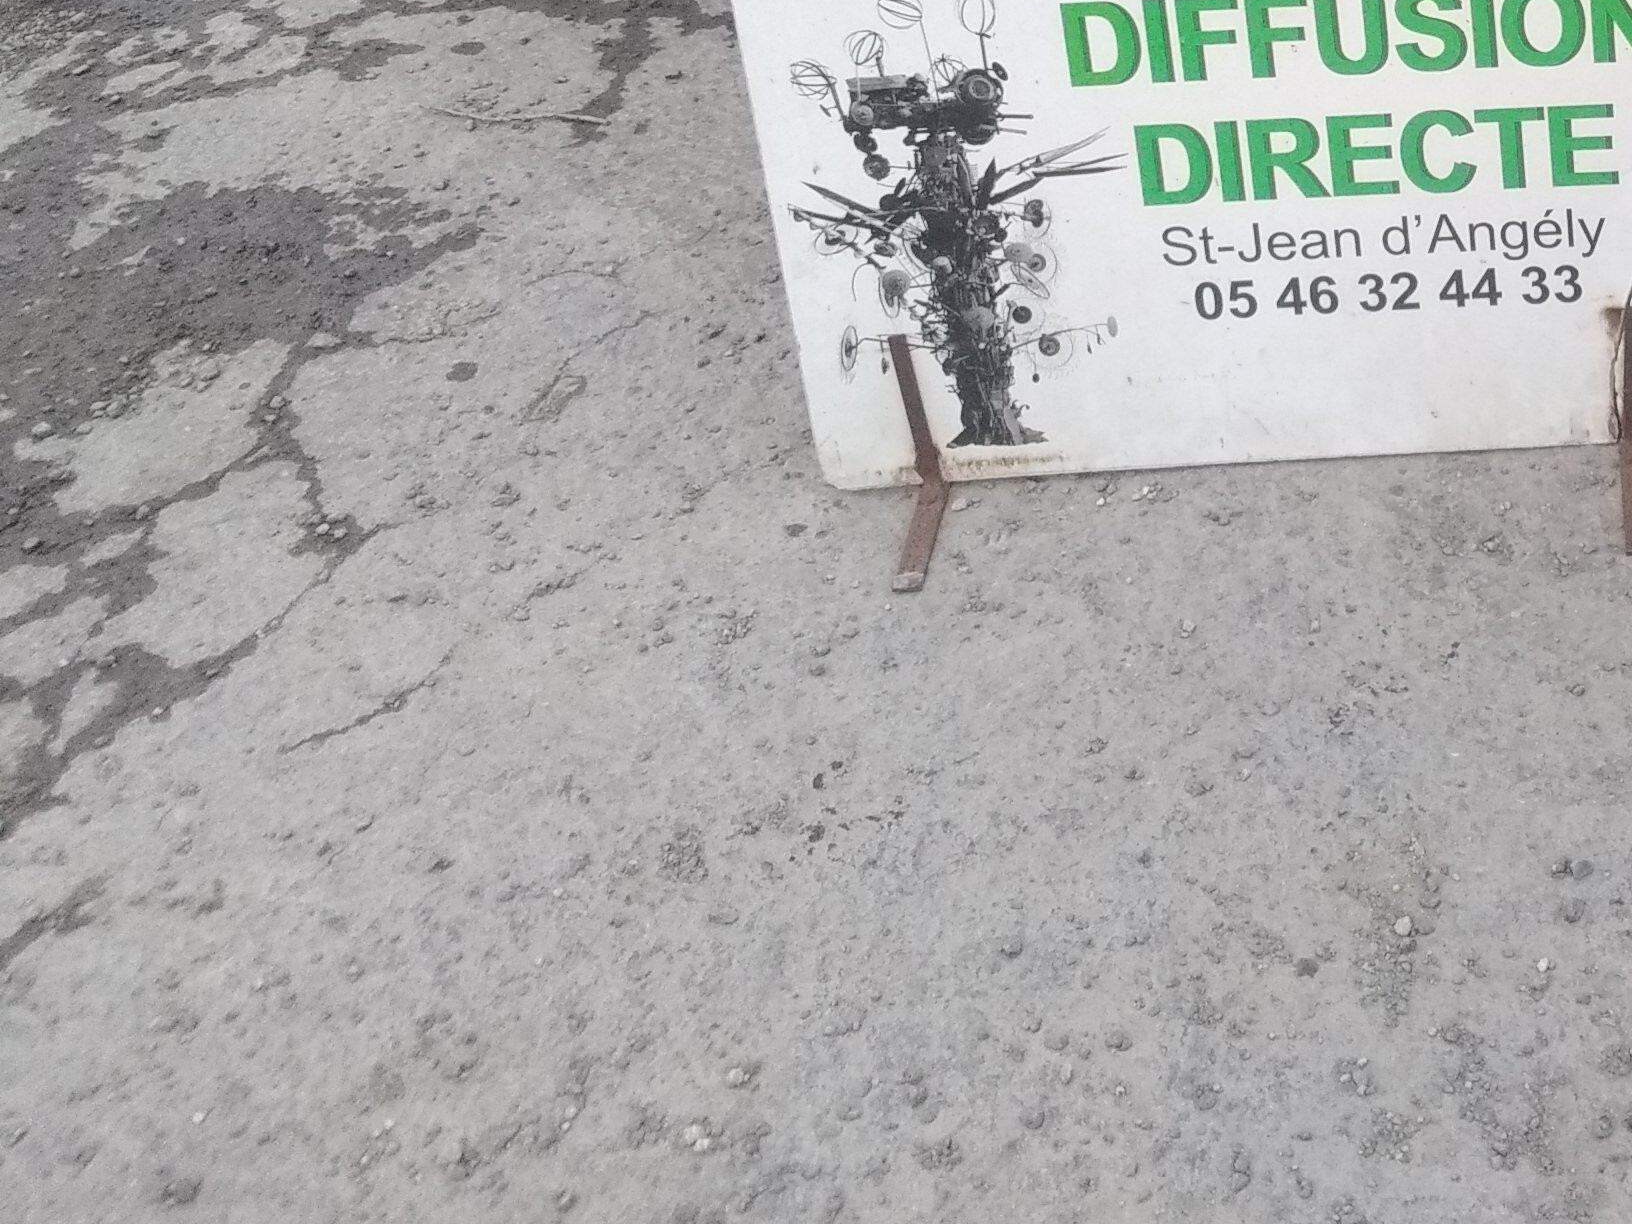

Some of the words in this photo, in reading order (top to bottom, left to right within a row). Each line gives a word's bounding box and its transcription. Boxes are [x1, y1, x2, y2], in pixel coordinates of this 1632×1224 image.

[1134, 103, 1621, 206] DIRECTE
[1162, 222, 1363, 266] St-Jean
[1382, 208, 1606, 261] d'Angély
[1194, 280, 1258, 321] 05
[1276, 276, 1340, 316] 46
[1358, 272, 1420, 312] 32
[1439, 267, 1503, 307] 44
[1521, 264, 1584, 305] 33
